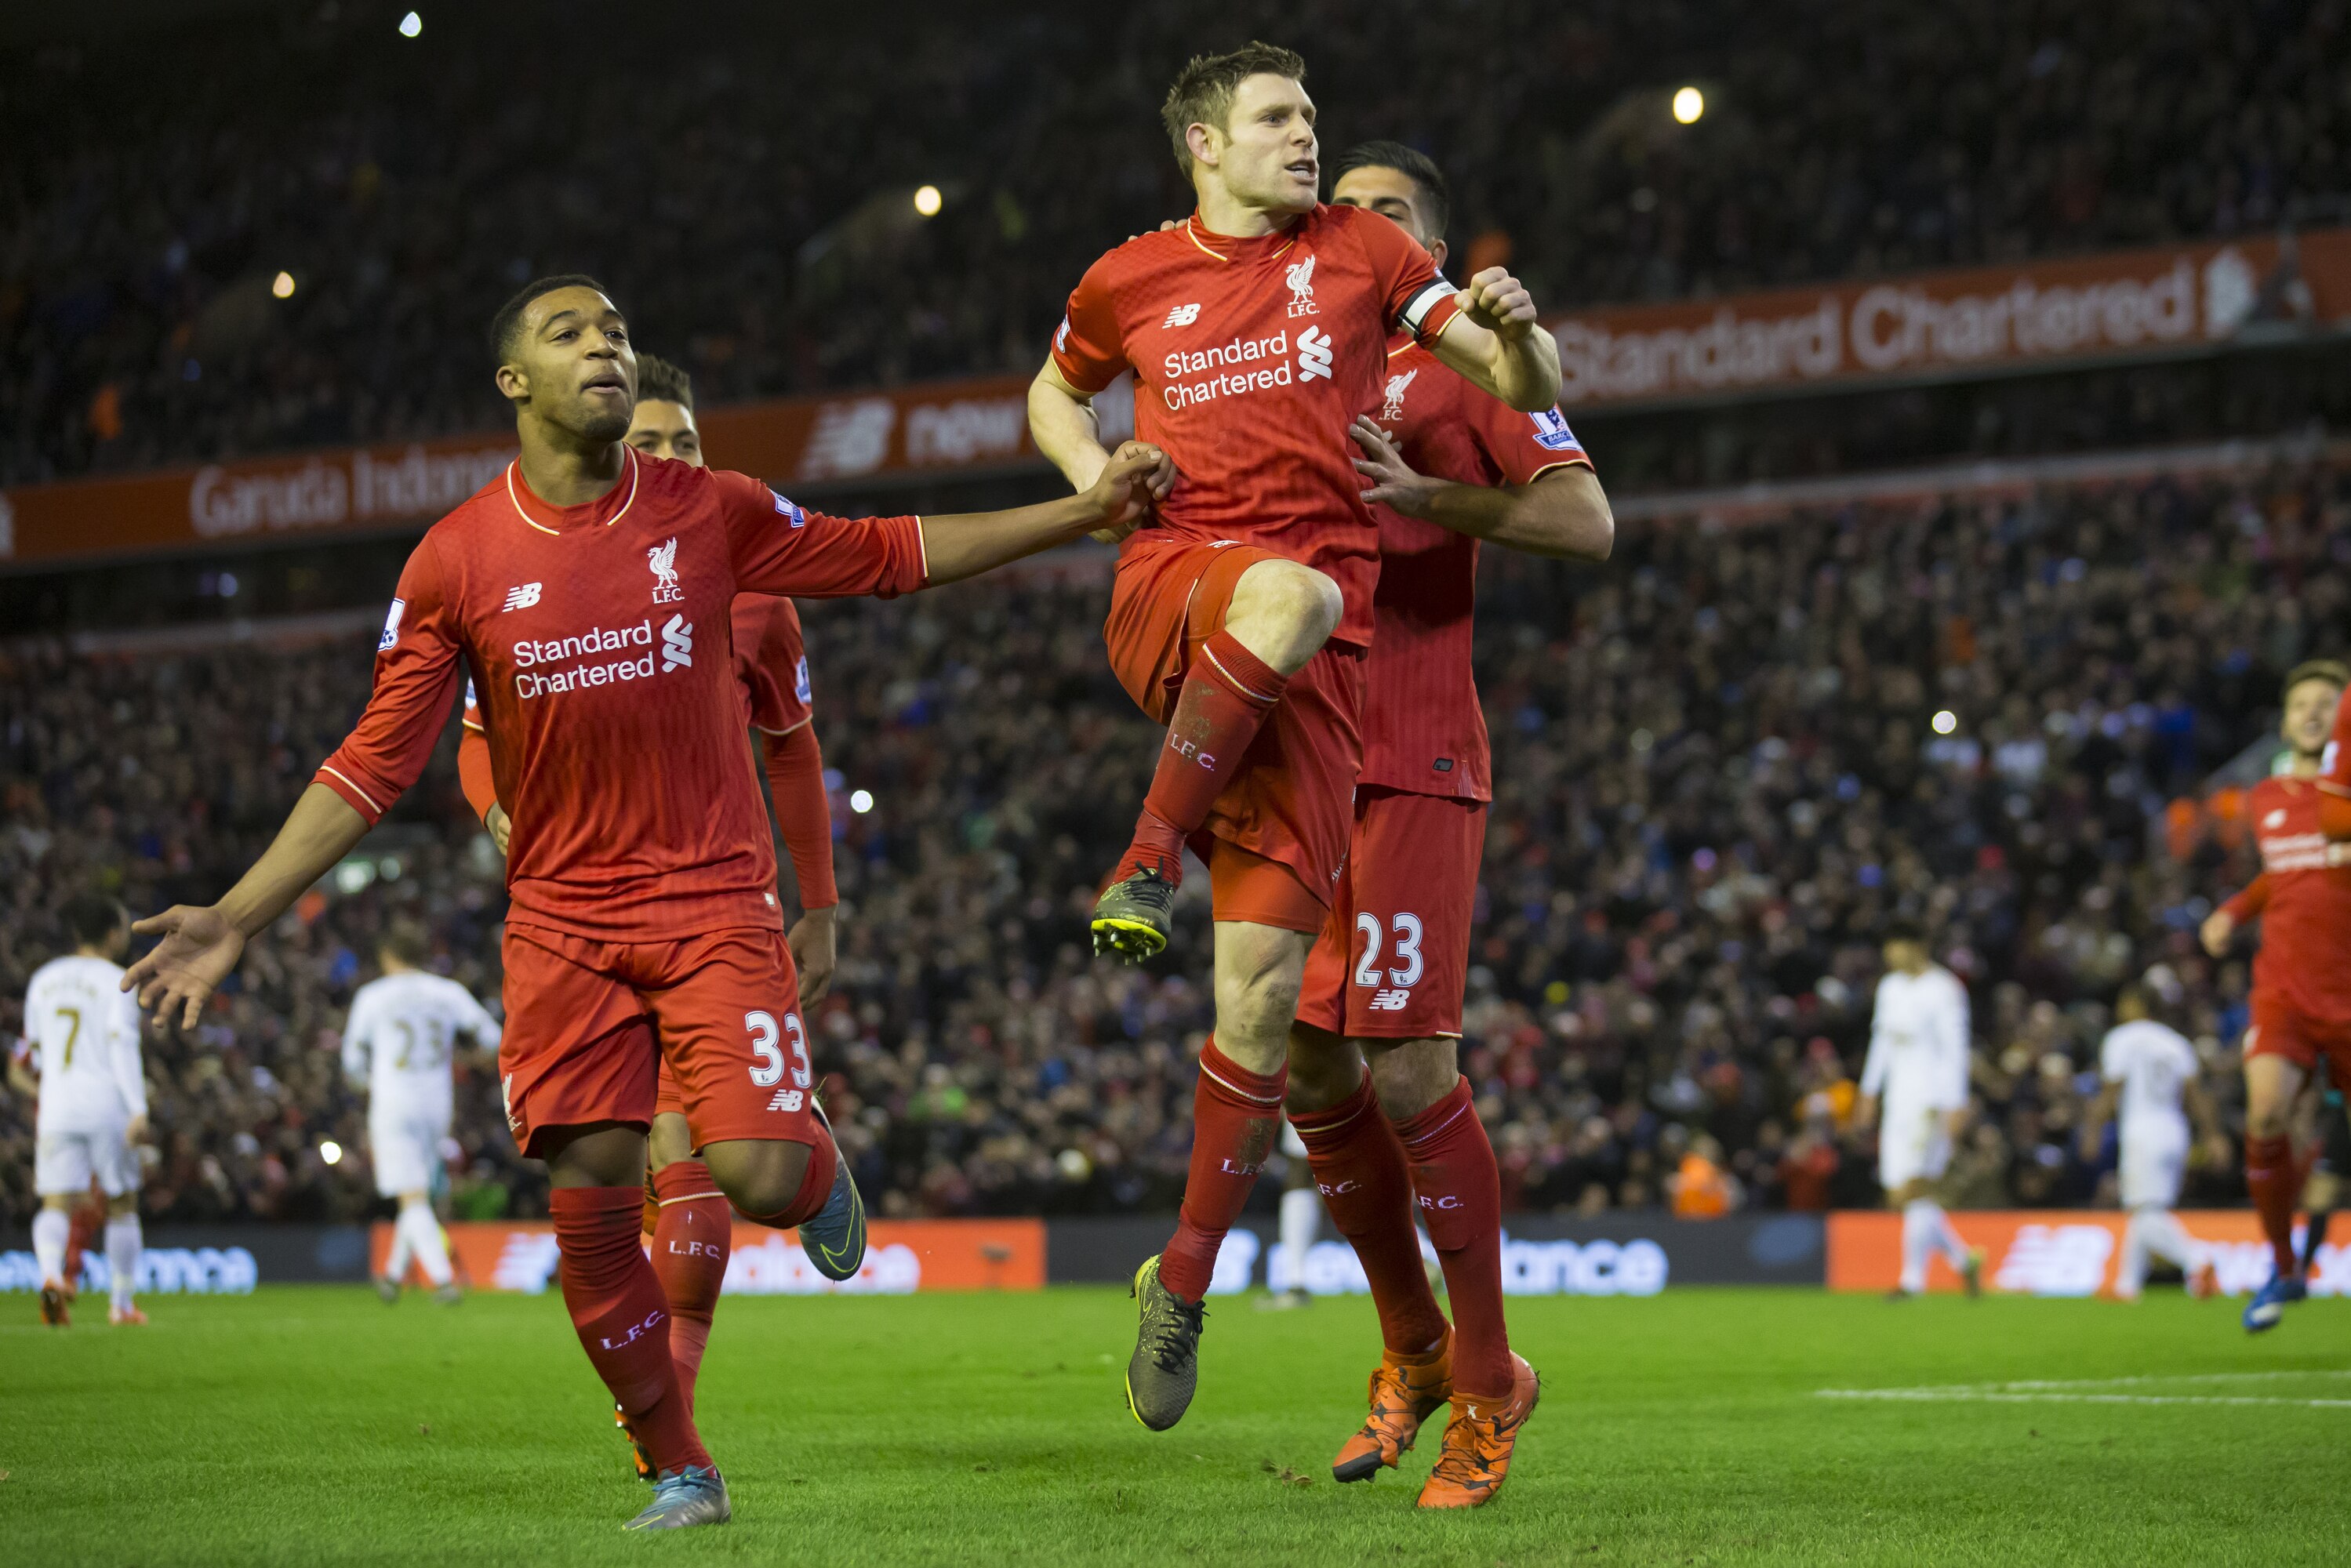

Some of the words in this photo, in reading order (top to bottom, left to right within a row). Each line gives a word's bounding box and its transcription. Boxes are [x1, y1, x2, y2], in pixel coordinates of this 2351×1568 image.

[1287, 303, 1321, 318] L.F.C.
[1551, 299, 1841, 398] Standard
[1851, 260, 2190, 367] Chartered
[1164, 330, 1288, 379] Standard
[1164, 361, 1292, 411] Chartered
[652, 588, 685, 604] L.F.C.
[513, 619, 652, 668] Standard
[515, 651, 655, 700] Chartered
[1355, 912, 1425, 989] 23
[56, 1007, 80, 1070] 7
[744, 1011, 812, 1088] 33
